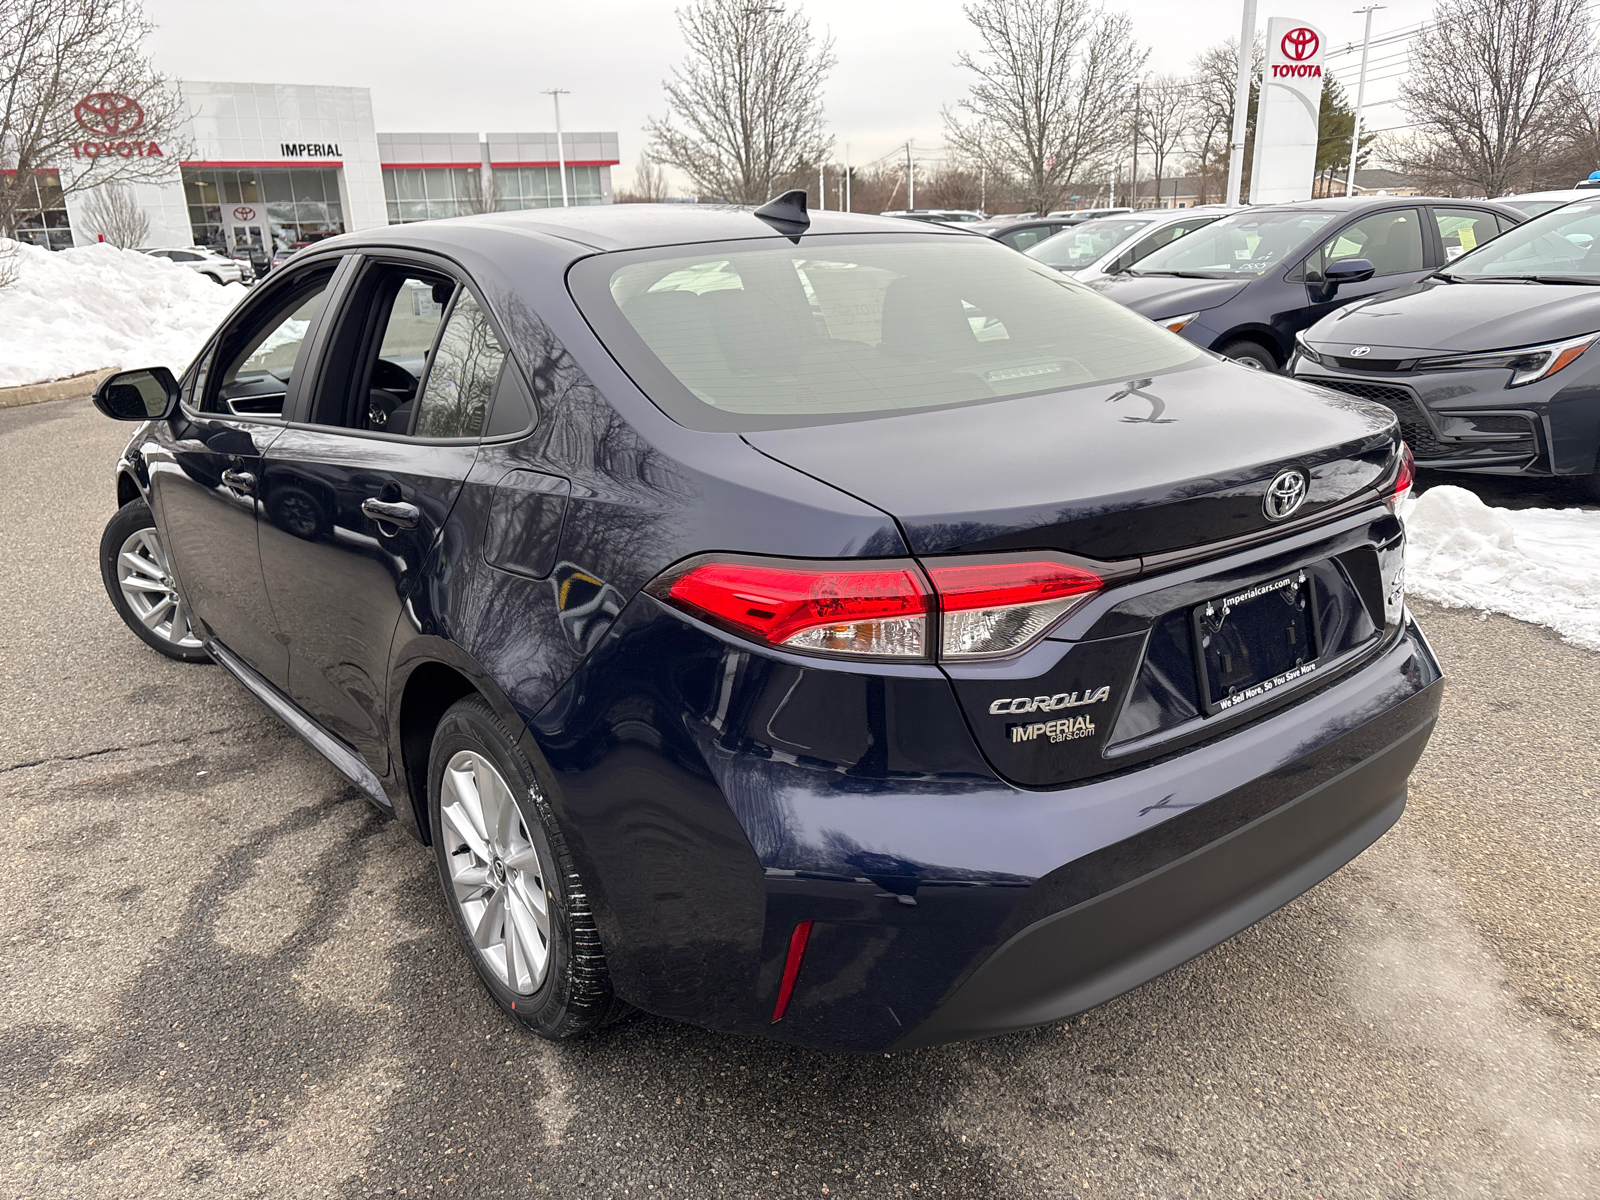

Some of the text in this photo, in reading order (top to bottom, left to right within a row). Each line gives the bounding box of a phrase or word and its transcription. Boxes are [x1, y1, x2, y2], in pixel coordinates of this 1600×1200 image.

[1271, 64, 1322, 78] TOYOTA
[68, 140, 163, 159] TOYOTA
[280, 143, 343, 157] IMPERIAL
[1223, 578, 1290, 608] Imperialcars.com
[1220, 662, 1316, 710] We Sell More, So You Save More
[988, 685, 1110, 715] COROLLA
[1011, 714, 1096, 743] IMPERIAL
[1050, 727, 1095, 744] cars.com
